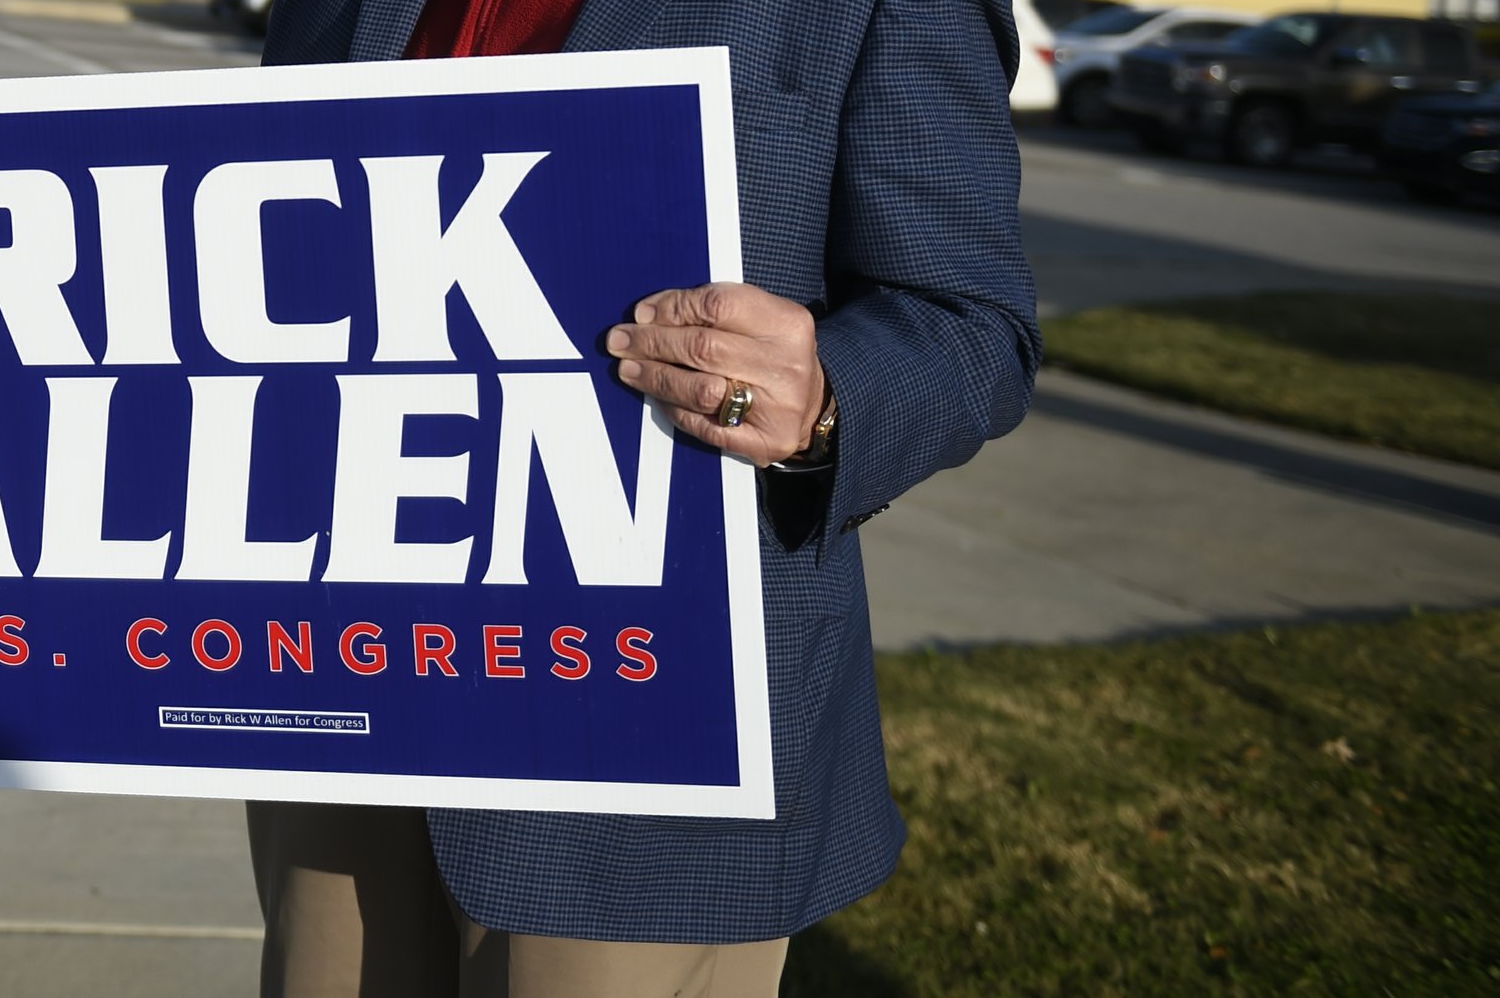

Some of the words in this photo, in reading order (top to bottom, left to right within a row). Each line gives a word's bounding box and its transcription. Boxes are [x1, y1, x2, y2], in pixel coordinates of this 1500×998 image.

[125, 617, 658, 682] CONGRESS
[165, 711, 188, 723] Paid
[190, 711, 206, 723] for
[209, 712, 222, 725] by
[224, 713, 247, 725] Rick
[249, 714, 261, 724] W
[264, 714, 292, 726] Allen
[294, 715, 311, 727] for
[313, 716, 364, 730] Congress
